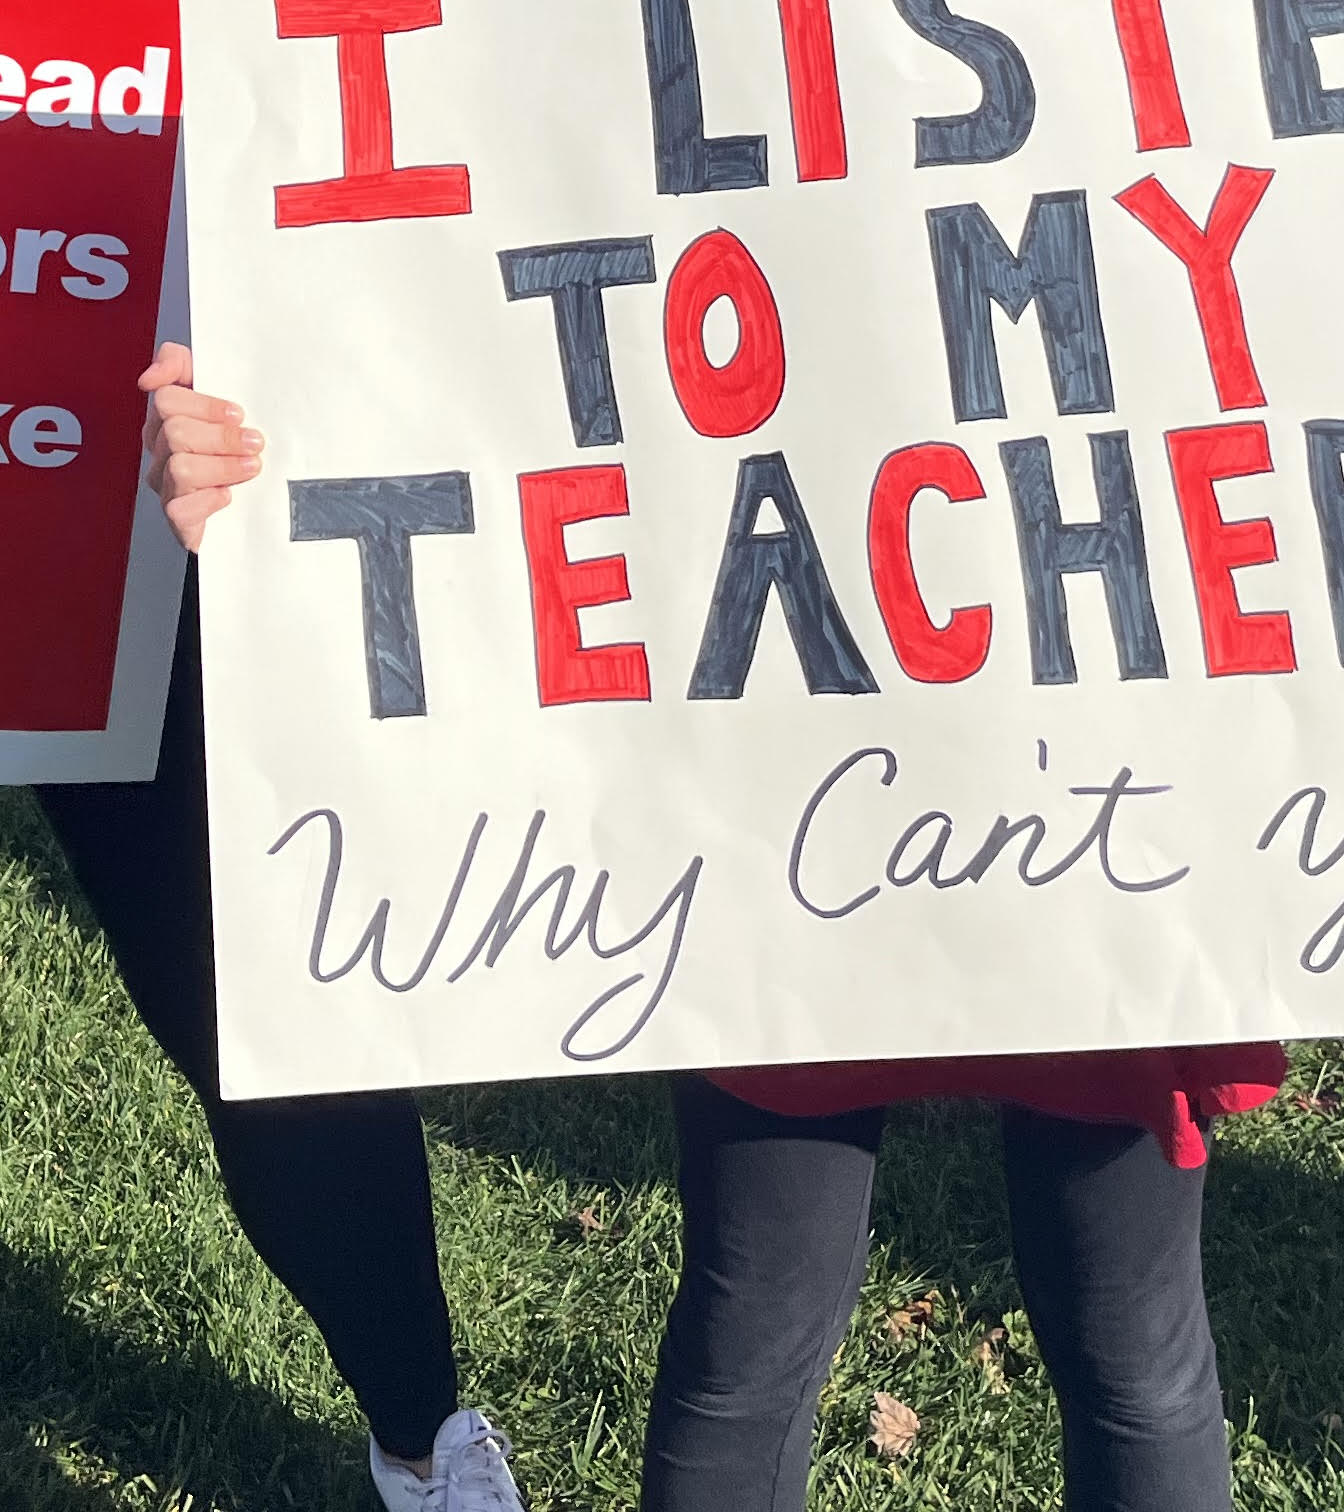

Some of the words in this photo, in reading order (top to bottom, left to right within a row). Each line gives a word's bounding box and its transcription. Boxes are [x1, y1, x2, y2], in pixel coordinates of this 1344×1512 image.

[497, 226, 787, 448] TO
[926, 162, 1276, 425] MY
[268, 808, 704, 1062] Why
[787, 739, 1191, 919] Can't
